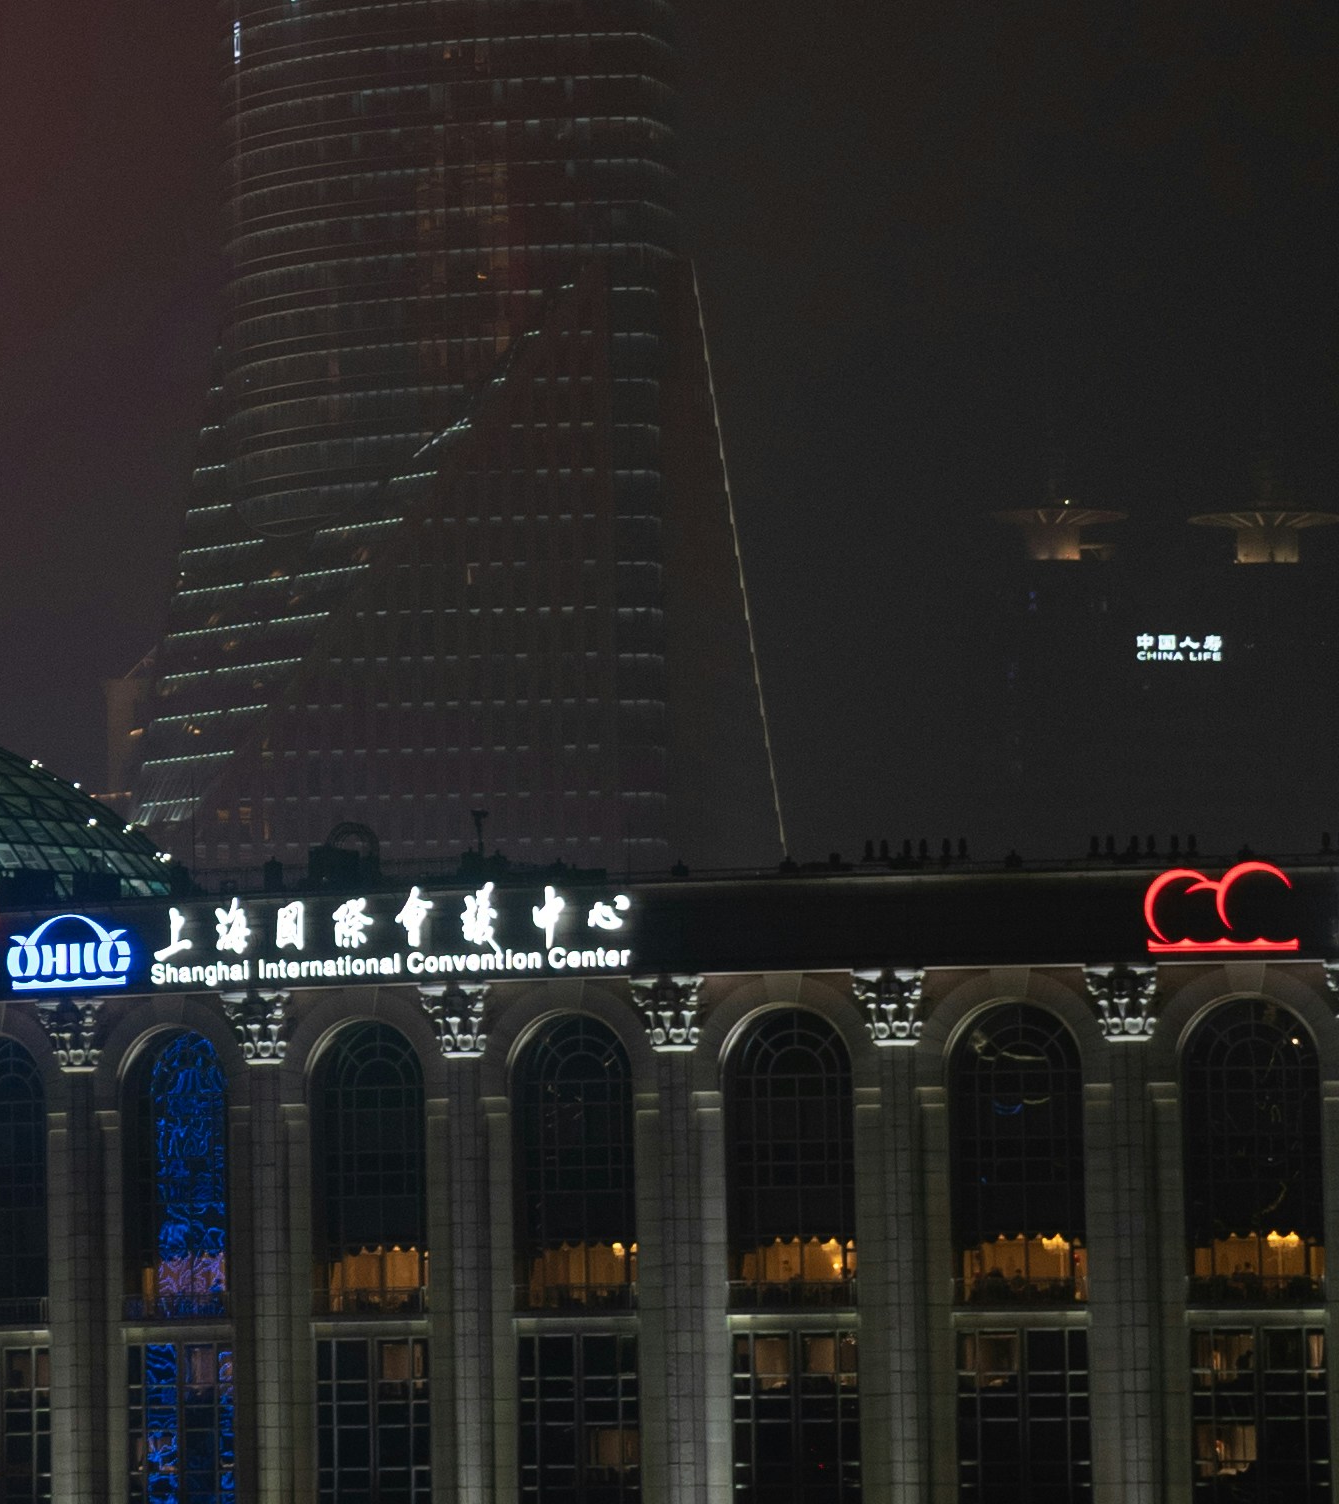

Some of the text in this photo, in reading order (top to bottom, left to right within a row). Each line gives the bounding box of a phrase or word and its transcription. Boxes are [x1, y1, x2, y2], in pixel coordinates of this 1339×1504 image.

[1136, 651, 1222, 662] CHINA LIFE
[150, 946, 631, 986] Shanghai International Convention Center
